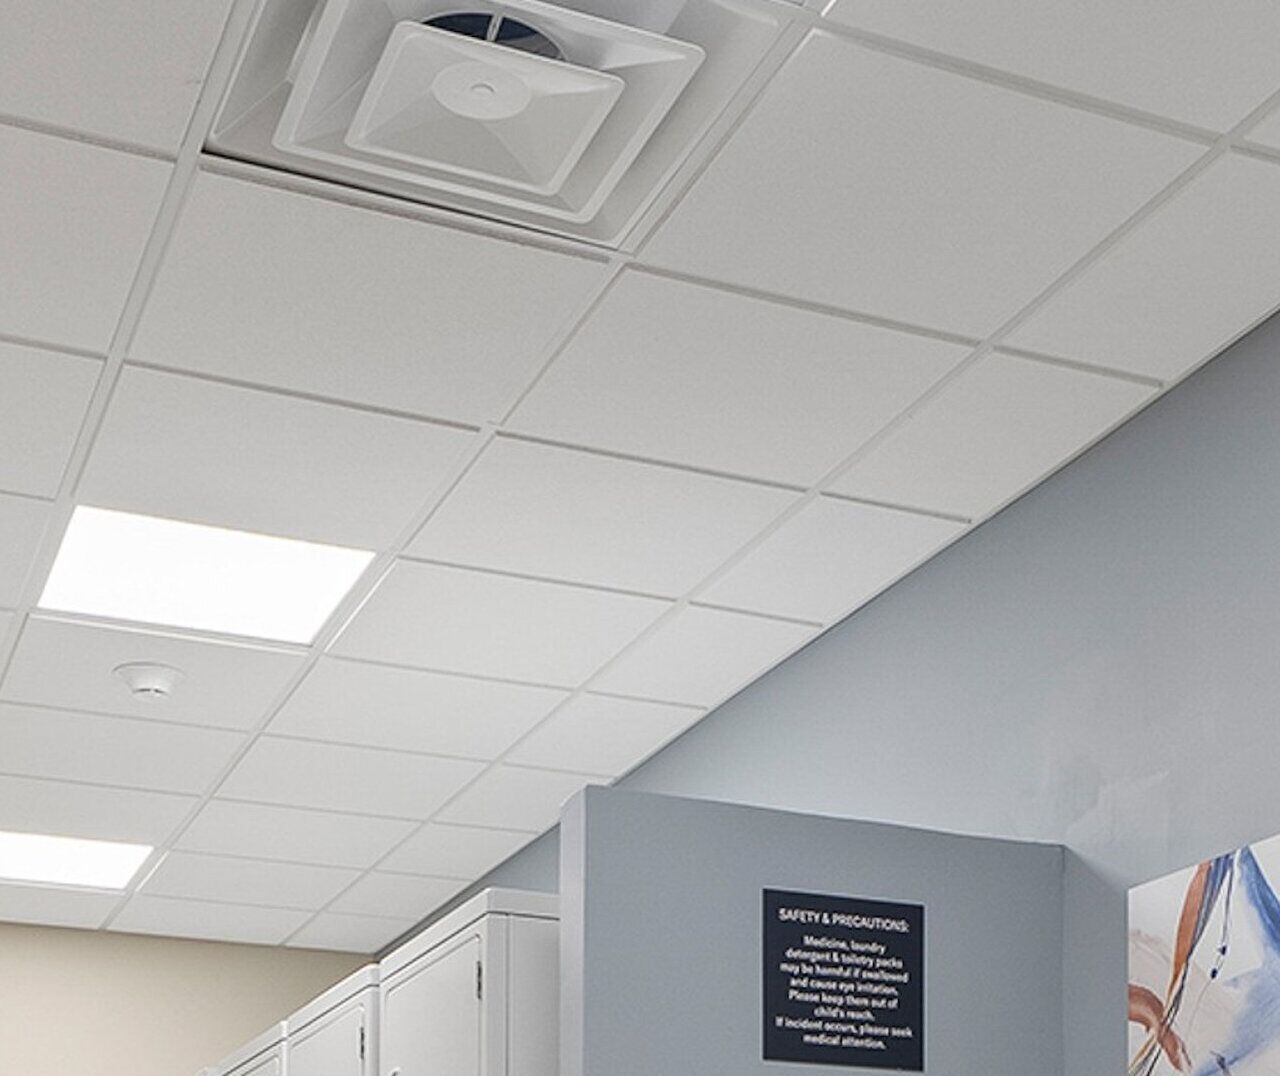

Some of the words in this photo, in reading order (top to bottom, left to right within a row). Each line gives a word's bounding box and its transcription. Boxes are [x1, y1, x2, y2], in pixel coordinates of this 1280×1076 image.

[779, 908, 820, 923] SAFETY
[822, 912, 830, 924] &
[851, 939, 886, 955] laundry
[785, 948, 830, 963] detergent
[780, 962, 800, 976] may
[801, 962, 814, 974] be
[815, 964, 851, 978] harmful
[853, 967, 860, 978] if
[861, 970, 909, 983] swallowed
[790, 977, 809, 988] and
[810, 979, 837, 990] cause
[838, 982, 855, 994] eye
[788, 989, 820, 1002] Please
[821, 991, 844, 1006] keep
[845, 994, 869, 1007] them
[871, 997, 887, 1009] out
[888, 998, 898, 1009] of
[775, 1016, 784, 1027] If
[784, 1016, 823, 1030] incident
[859, 1023, 889, 1036] please
[891, 1026, 913, 1038] seek
[802, 1033, 840, 1046] medical
